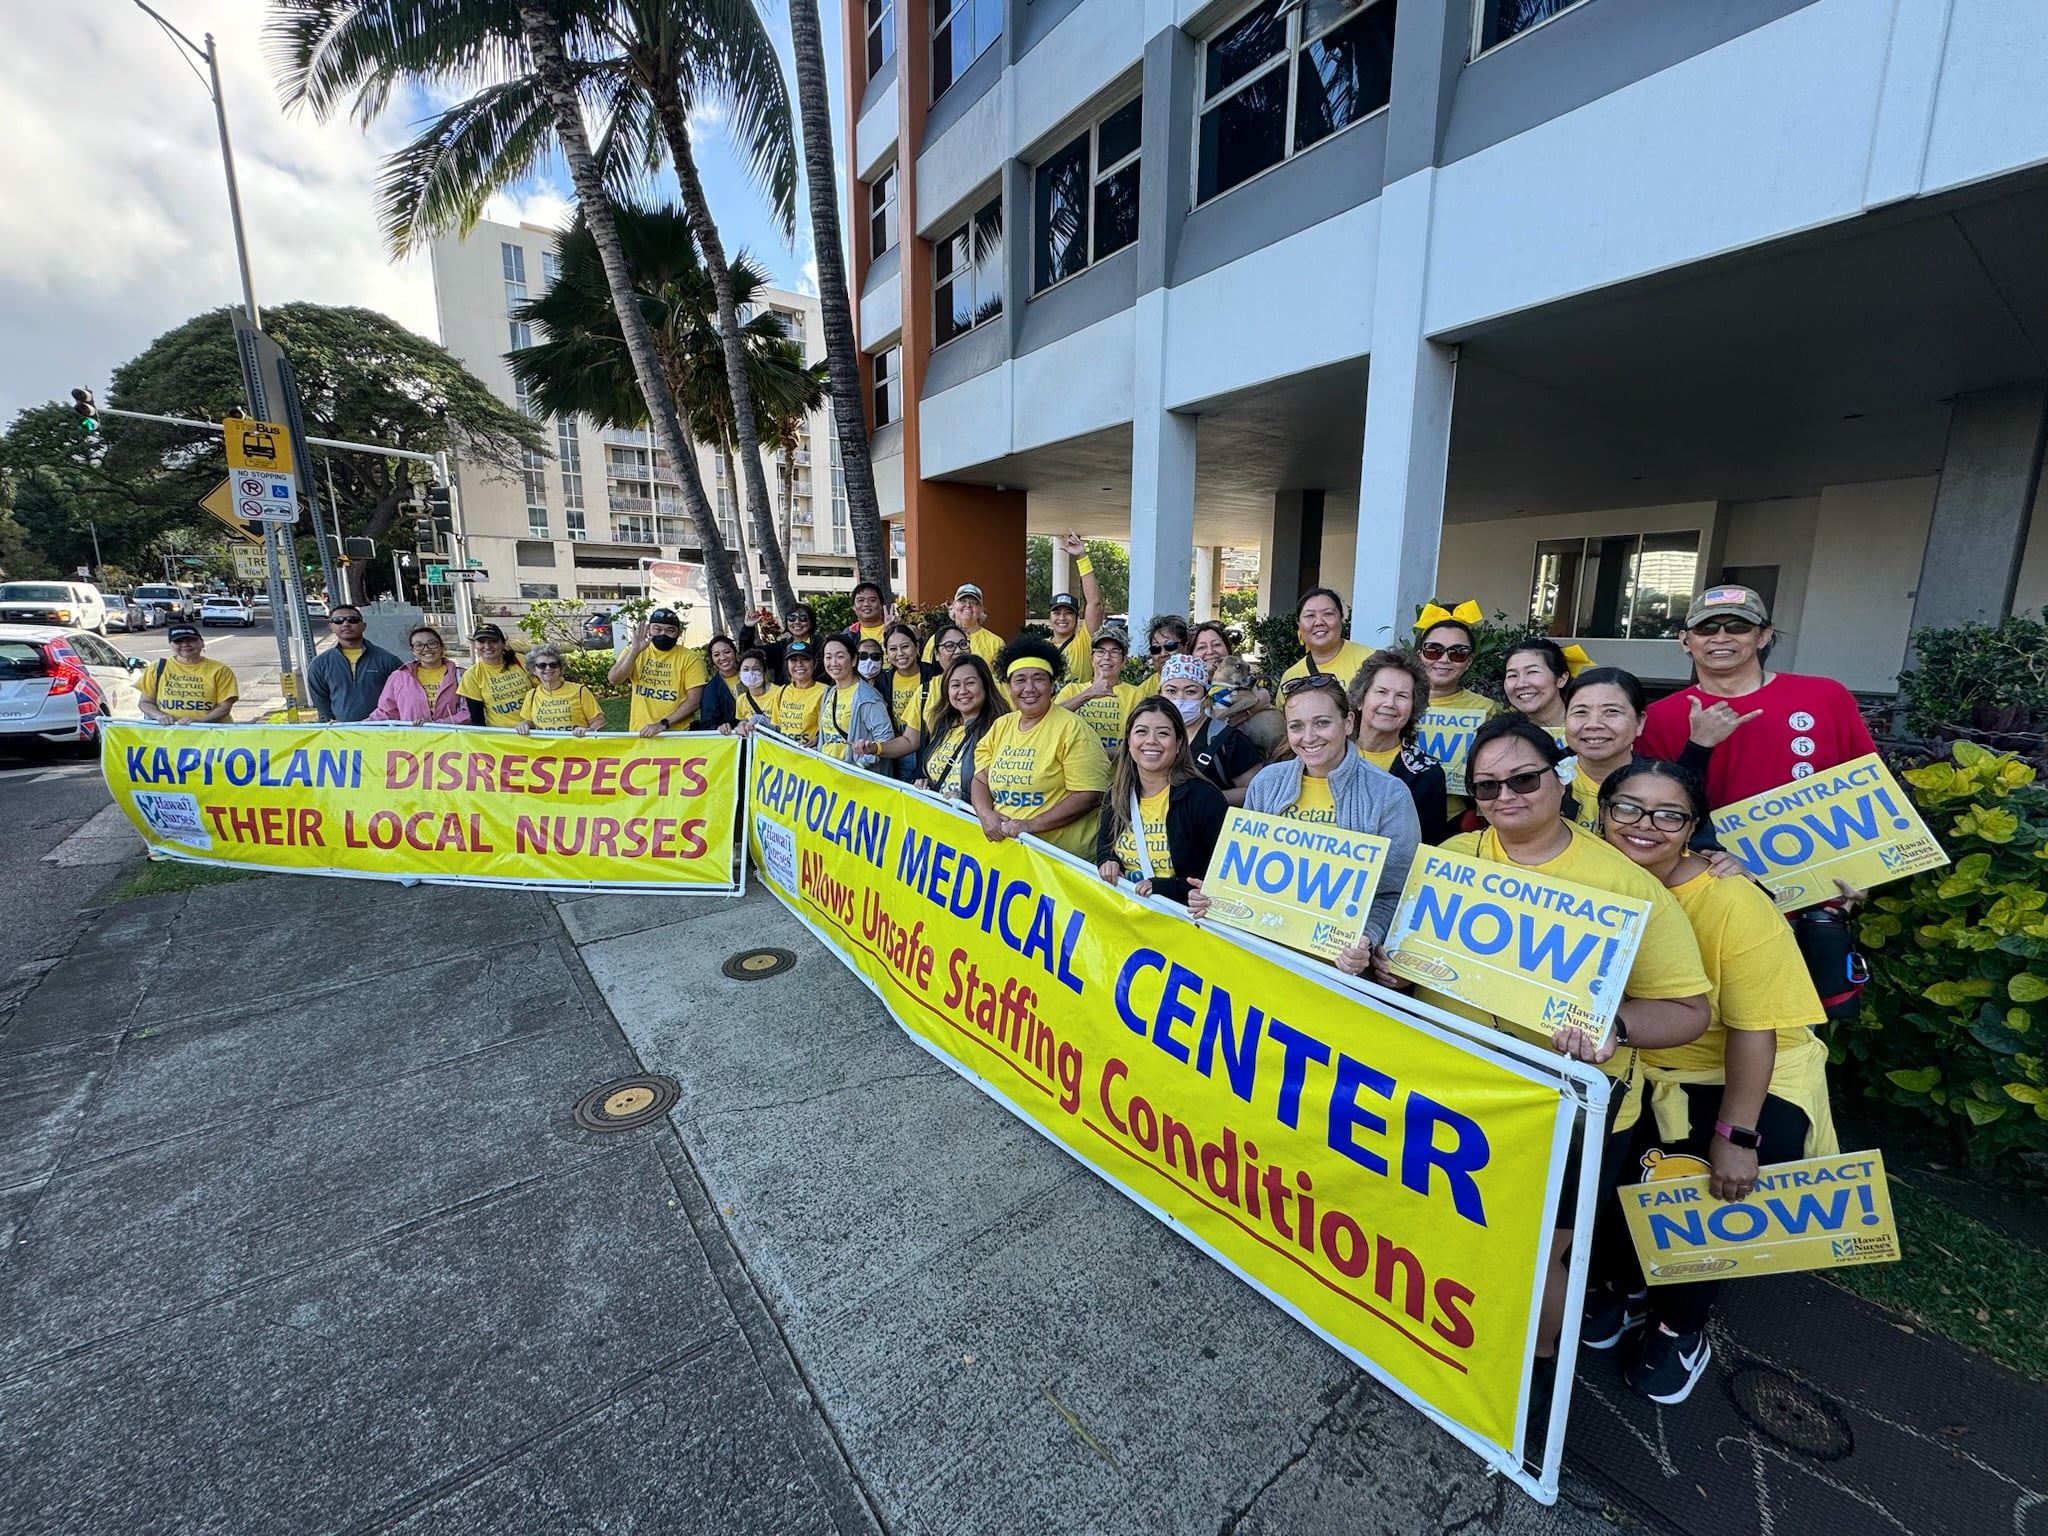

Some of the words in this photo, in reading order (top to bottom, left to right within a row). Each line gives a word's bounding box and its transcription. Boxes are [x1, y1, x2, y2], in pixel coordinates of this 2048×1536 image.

[251, 471, 287, 480] STOPPING
[642, 665, 671, 677] Recruit
[646, 658, 671, 669] Retain
[168, 673, 203, 682] Retain
[490, 672, 520, 684] Retain
[639, 674, 671, 687] Respect
[164, 688, 206, 698] Respect
[165, 681, 204, 690] Recruit
[491, 678, 524, 693] Recruit
[492, 685, 529, 701] Respect
[159, 699, 213, 711] NURSES
[491, 698, 525, 714] NURS
[538, 706, 571, 715] Recruit
[541, 699, 569, 707] Retain
[536, 715, 572, 724] Respect
[1078, 709, 1120, 720] Recruit
[1420, 713, 1481, 728] NTRACT
[1001, 744, 1037, 757] Retain
[993, 758, 1034, 771] Recruit
[385, 750, 708, 797] DISRESPECTS
[990, 770, 1033, 787] Respect
[1713, 813, 1747, 836] AIR
[1748, 764, 1881, 822] CONTRACT
[206, 805, 326, 847] THEIR
[345, 810, 494, 852] LOCAL
[516, 815, 708, 860] NURSES
[1231, 817, 1269, 839] FAIR
[1273, 826, 1382, 864] CONTRACT
[1218, 839, 1369, 917] NOW!
[1424, 857, 1476, 887] FAIR
[1481, 873, 1639, 930] CONTRACT
[1408, 884, 1620, 996] NOW!
[896, 826, 1086, 995] MEDICAL
[1114, 948, 1491, 1228] CENTER
[801, 848, 855, 926] Allows
[862, 886, 935, 991] Unsafe
[943, 948, 1083, 1115] Staffing
[1100, 1057, 1476, 1349] Conditions
[1637, 1187, 1702, 1208] FAIR
[1752, 1160, 1876, 1193] NTRACT
[1648, 1184, 1880, 1250] NOW!
